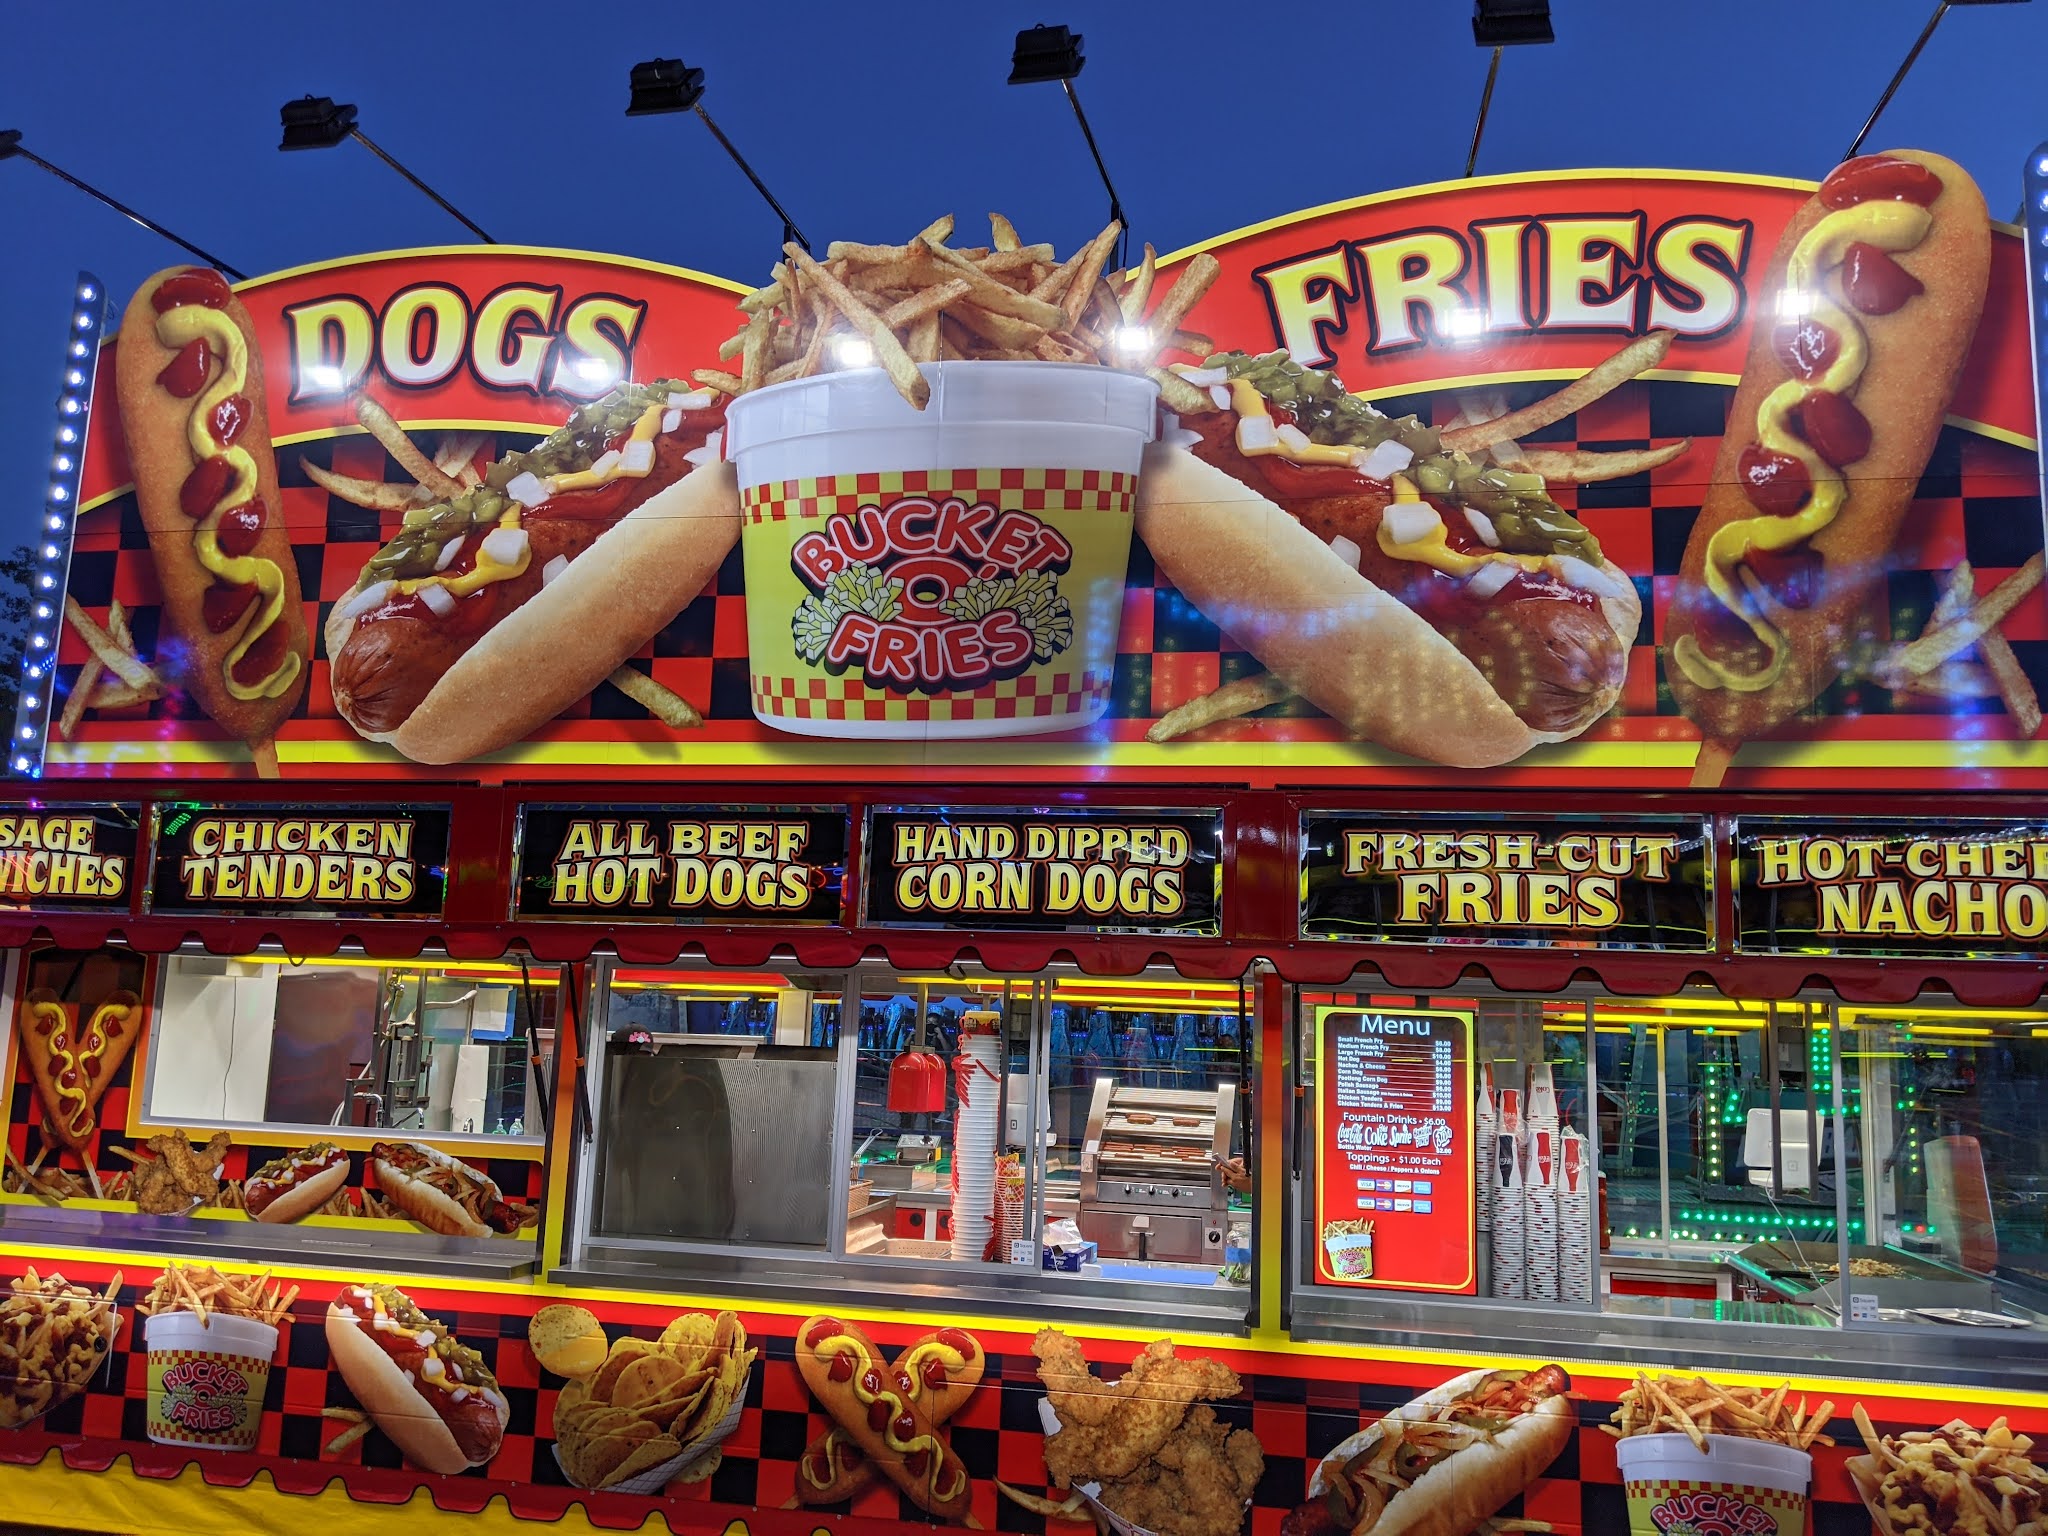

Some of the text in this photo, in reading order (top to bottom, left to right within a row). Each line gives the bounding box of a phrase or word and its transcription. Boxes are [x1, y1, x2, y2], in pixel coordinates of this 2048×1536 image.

[1253, 210, 1752, 367] FRIES
[284, 282, 647, 404] DOGS
[791, 497, 1072, 588] BUCKET
[825, 610, 1035, 688] FRIES
[0, 818, 94, 854] SAGE
[191, 819, 414, 858] CHICKEN
[559, 822, 808, 861] ALL BEEF
[895, 825, 1188, 867] HAND DIPPED
[1345, 832, 1677, 880] FRESH-CUT
[182, 853, 414, 900] TENDERS
[552, 857, 811, 907] HOT DOGS
[898, 861, 1183, 914] CORN DOGS
[1397, 872, 1620, 927] FRIES
[1820, 880, 2048, 937] NACHO
[1361, 1014, 1431, 1037] Menu
[1355, 1082, 1379, 1090] Sausage
[1343, 1112, 1446, 1126] Fountain Drinks $6.00
[1365, 1127, 1388, 1147] Coke
[1389, 1124, 1412, 1147] Sprite
[1346, 1152, 1441, 1166] Toppings $1.00 Each
[1391, 1166, 1413, 1174] Peppers
[162, 1361, 249, 1394] BUCKET
[171, 1401, 237, 1431] FRIES
[1651, 1494, 1778, 1535] BUCKET
